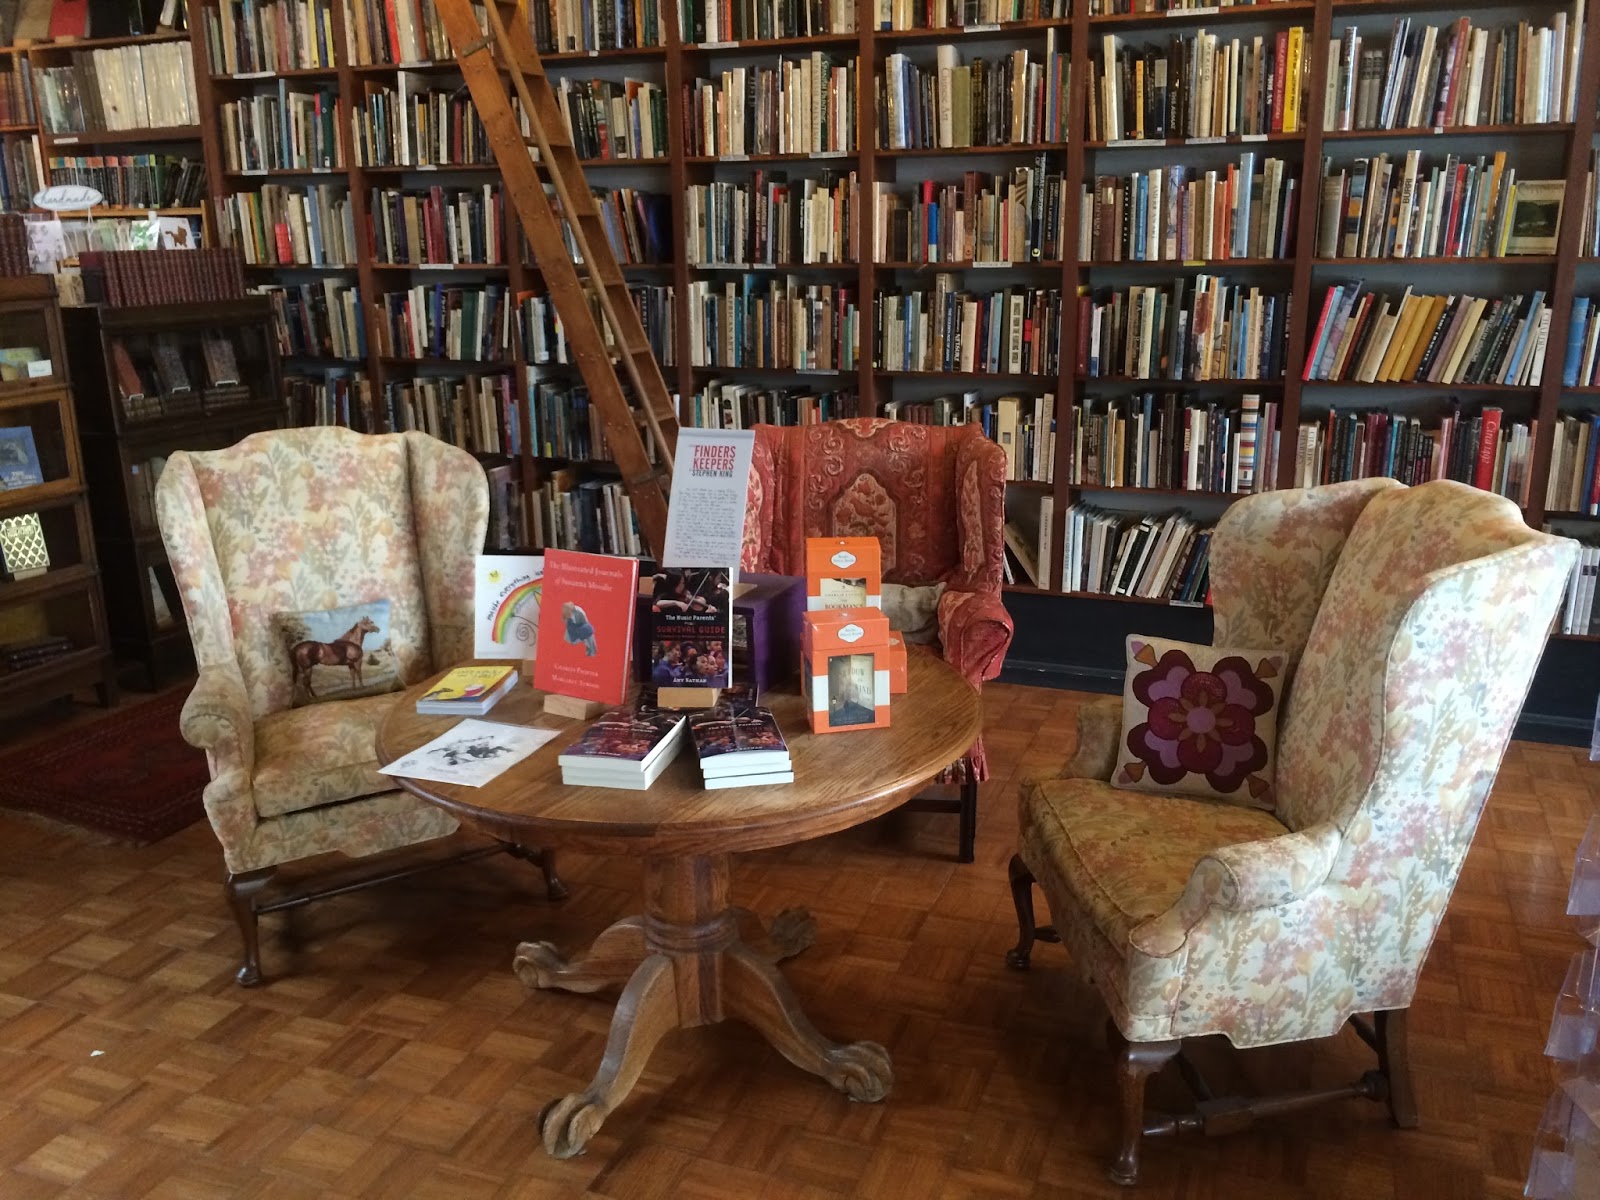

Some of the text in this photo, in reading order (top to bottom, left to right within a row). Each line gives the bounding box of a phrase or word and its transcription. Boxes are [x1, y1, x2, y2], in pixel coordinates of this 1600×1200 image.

[812, 60, 821, 97] SPANISH
[1204, 42, 1212, 81] MEXICO
[821, 60, 830, 123] SPANISH PAINTING
[941, 68, 952, 121] Chinese Art
[1402, 178, 1413, 204] BURRI
[1537, 313, 1550, 352] CHARDIN
[694, 445, 736, 459] FINDERS
[1297, 429, 1308, 465] CHARDIN
[1305, 431, 1315, 467] CHARDIN
[1480, 421, 1497, 464] Circa 1492
[691, 469, 733, 478] STEPHEN KING
[692, 458, 735, 471] KEEPERS
[550, 562, 623, 578] The Illustrated Journals
[562, 579, 587, 588] Susanna
[587, 582, 613, 592] Moodie
[487, 574, 531, 621] maybe everything
[656, 626, 725, 634] SURVIVAL GUIDE
